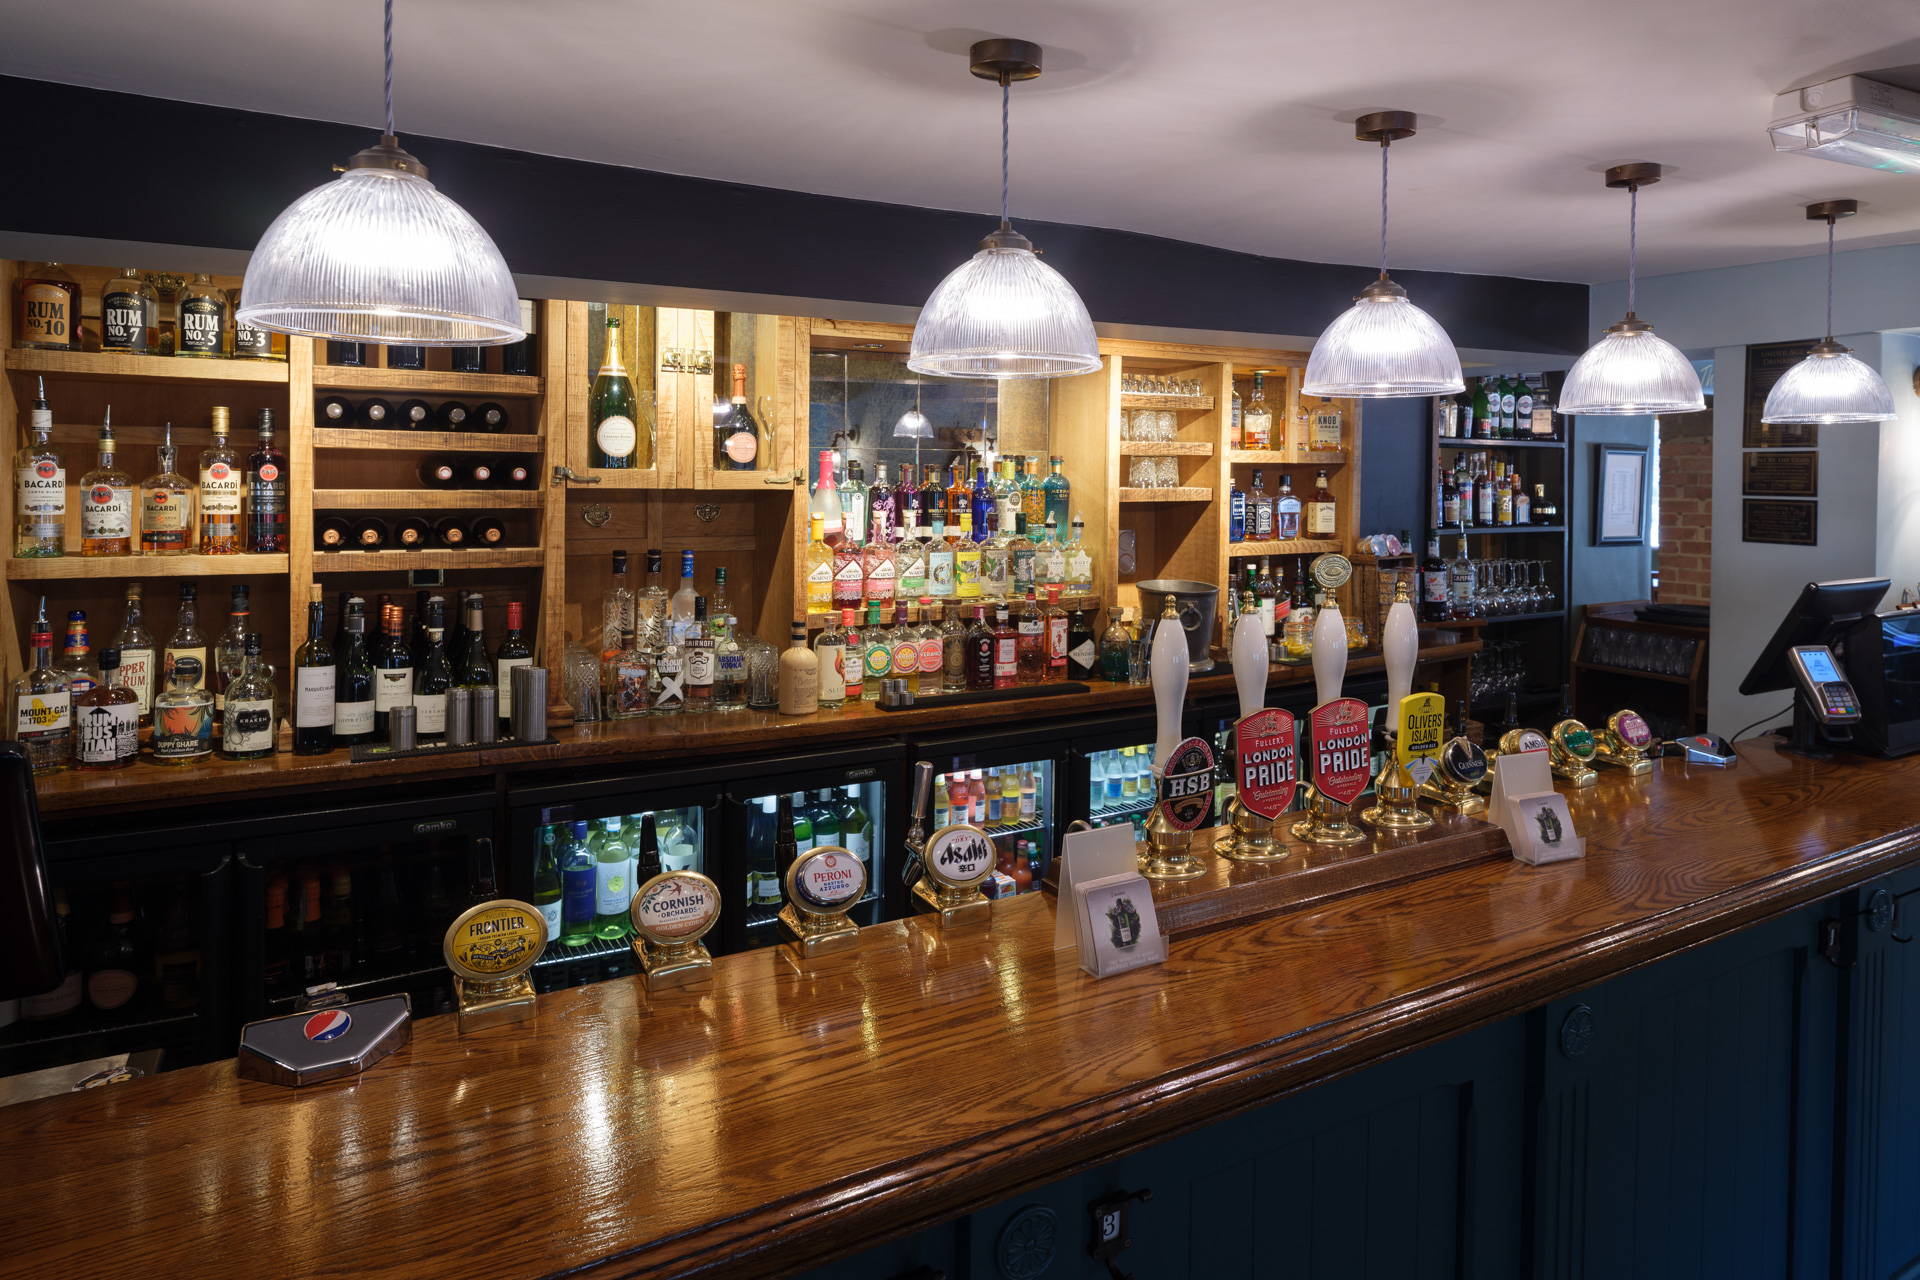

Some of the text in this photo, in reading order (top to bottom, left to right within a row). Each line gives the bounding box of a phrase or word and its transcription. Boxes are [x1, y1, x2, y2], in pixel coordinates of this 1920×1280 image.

[27, 301, 64, 319] RUM
[106, 308, 142, 326] RUM
[44, 320, 65, 336] 10
[184, 313, 219, 332] RUM
[108, 325, 139, 342] NO. 7
[185, 330, 217, 345] NO. 5
[237, 330, 266, 347] NO. 3
[119, 661, 145, 677] PPER
[123, 676, 146, 687] RUM
[20, 705, 68, 718] MOUNT GAY
[28, 716, 47, 725] 1703
[84, 713, 116, 727] RUM
[84, 725, 113, 740] BUS
[1329, 725, 1359, 735] FULLER'S
[1411, 728, 1438, 742] ISLAND
[83, 737, 116, 752] TIAN
[176, 739, 199, 748] SHARE
[1255, 736, 1285, 747] FULLER'S
[1319, 732, 1367, 751] LONDON
[1244, 744, 1294, 764] LONDON
[1319, 746, 1369, 774] PRIDE
[1458, 761, 1484, 769] GUINNESS
[848, 769, 874, 778] Gamko
[1244, 759, 1294, 789] PRIDE
[1169, 773, 1210, 797] HSB
[417, 821, 453, 833] Gamko
[941, 838, 988, 865] Asahi
[959, 864, 975, 872] 辛口
[813, 869, 852, 883] PERONI
[819, 883, 850, 892] AZZURRO
[652, 895, 704, 913] CORNISH
[661, 907, 697, 918] ORCHARDS
[470, 916, 525, 937] FRONTIER
[1103, 1214, 1115, 1236] 3
